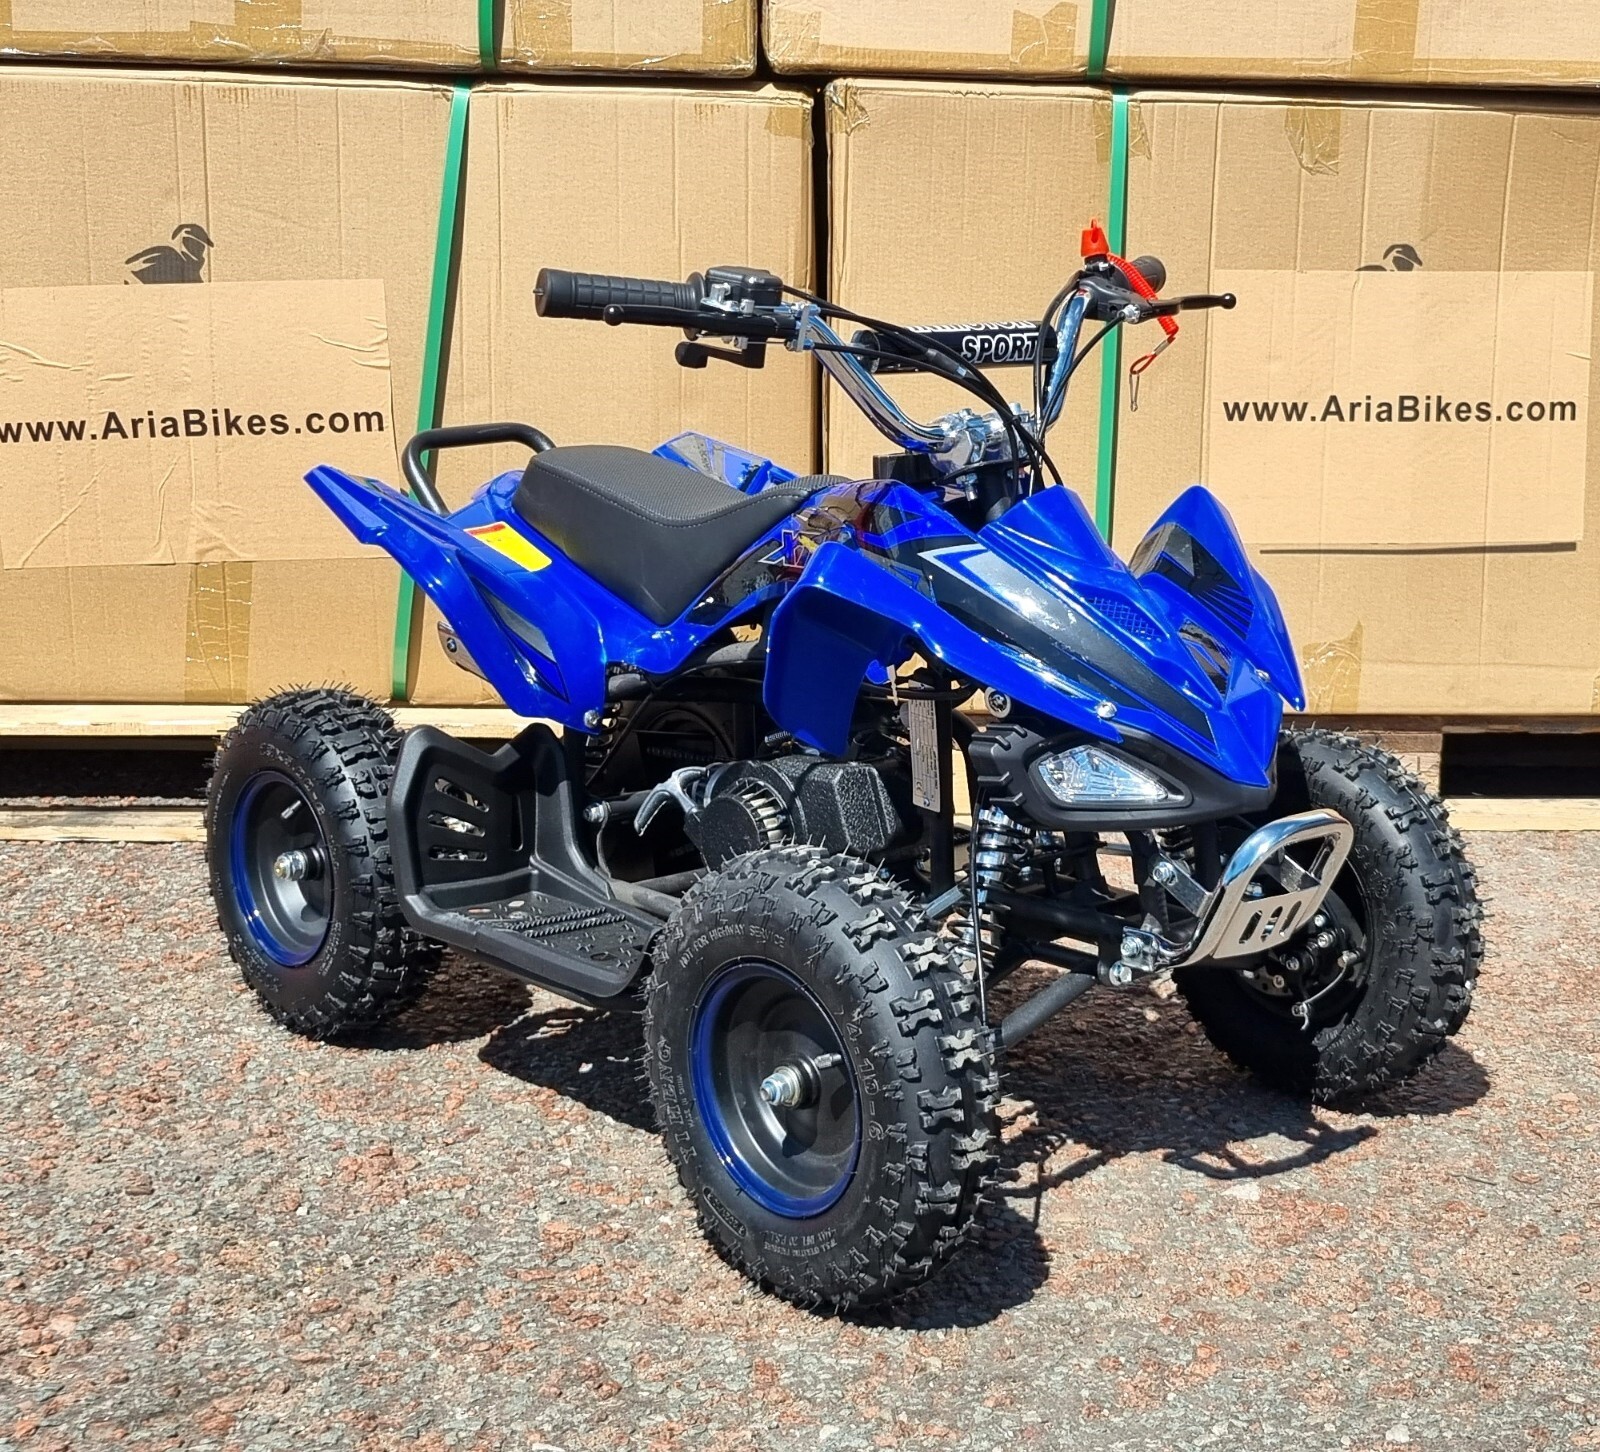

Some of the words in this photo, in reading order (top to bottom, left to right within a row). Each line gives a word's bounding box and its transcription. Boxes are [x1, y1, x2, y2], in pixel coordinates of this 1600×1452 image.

[960, 332, 1040, 363] SPORT
[1223, 395, 1577, 423] www.AriaBikes.com
[679, 947, 694, 969] NOT
[693, 934, 710, 952] FOR
[708, 923, 746, 941] HIGHWAY
[749, 924, 785, 949] SERVICE
